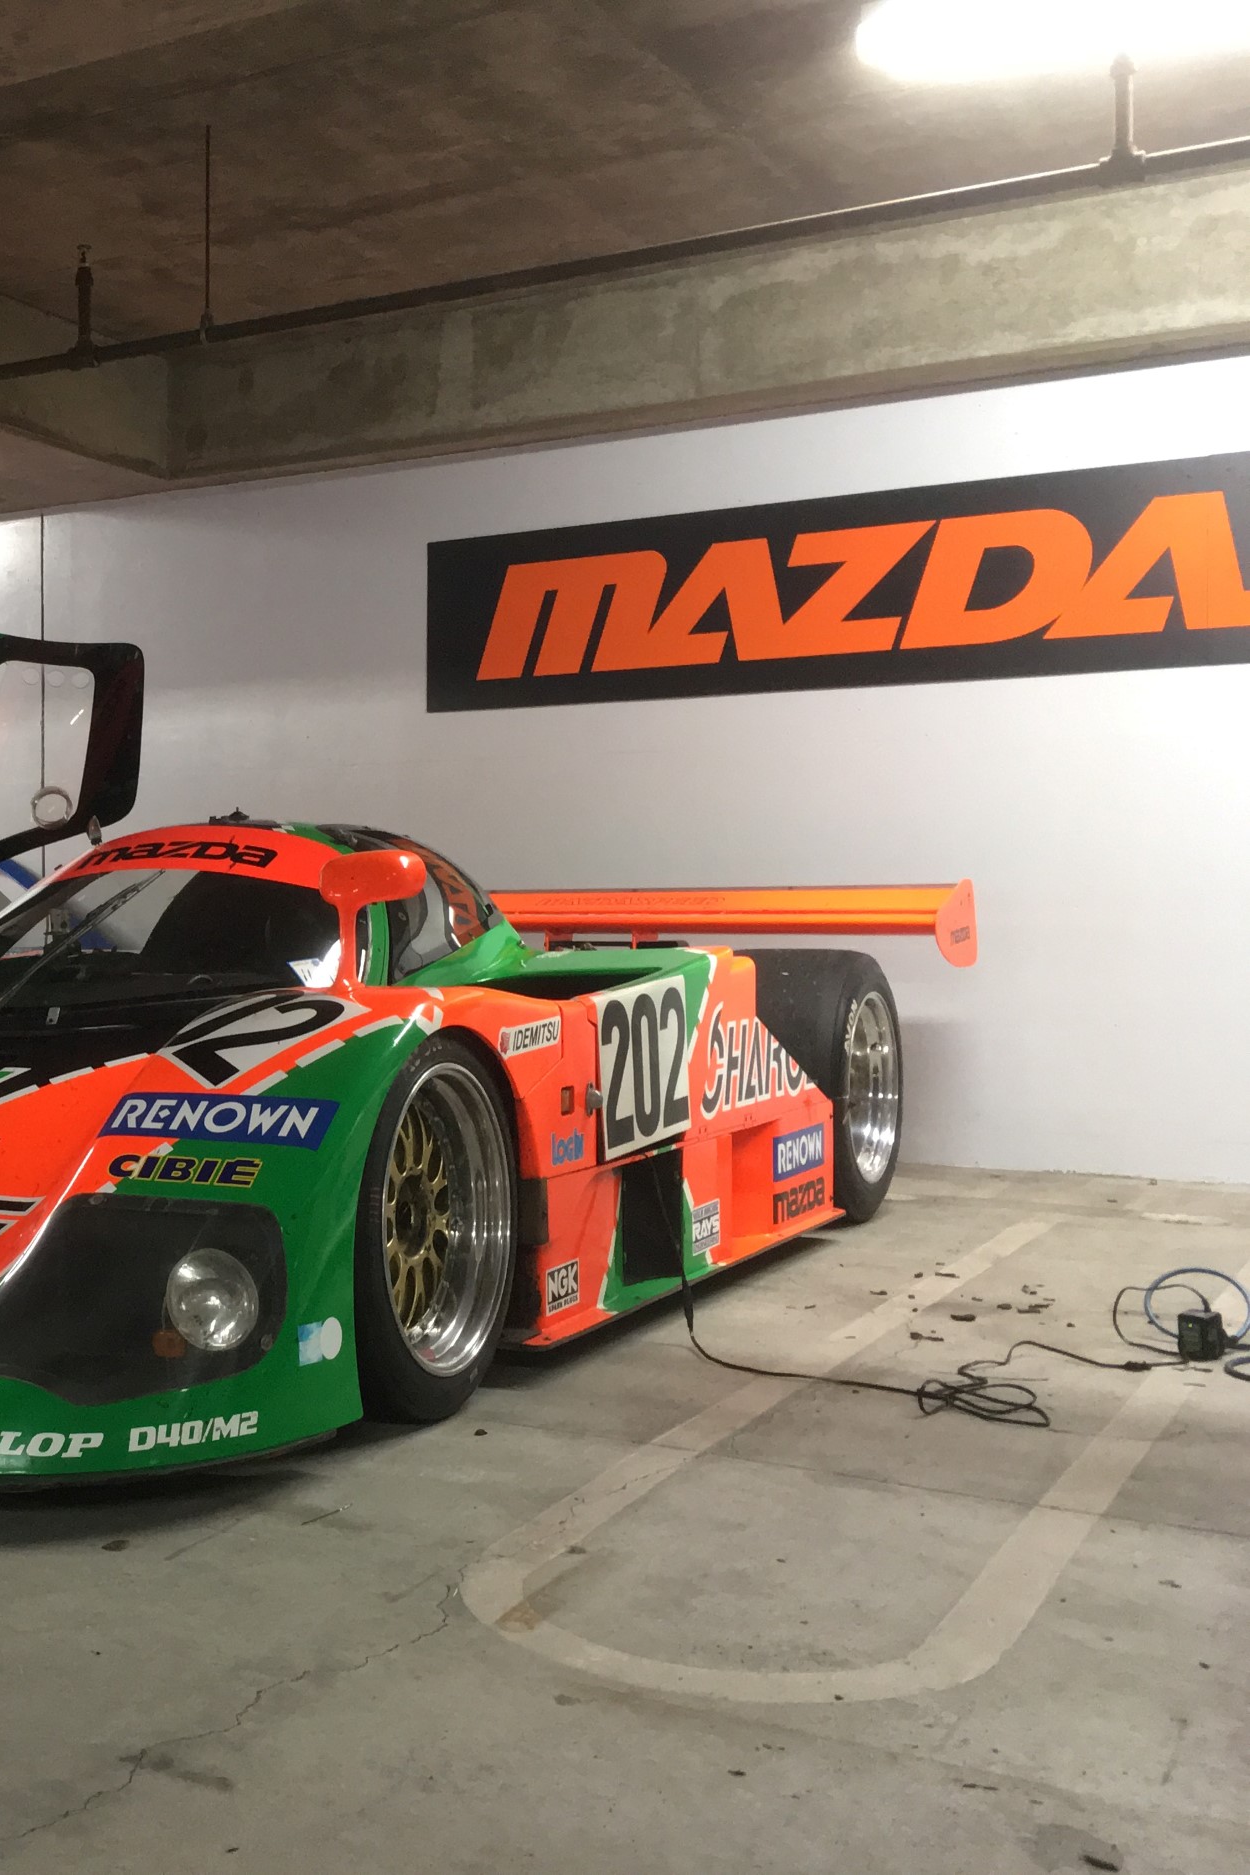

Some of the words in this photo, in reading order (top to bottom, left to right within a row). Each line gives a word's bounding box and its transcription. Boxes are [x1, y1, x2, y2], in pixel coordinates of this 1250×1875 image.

[512, 1018, 560, 1052] IDEMITSU
[601, 987, 690, 1150] 202
[111, 1098, 320, 1140] RENOWN
[777, 1130, 823, 1175] RENOWN
[693, 1213, 720, 1244] RAYS
[548, 1263, 578, 1304] NGK
[128, 1410, 259, 1453] D40/M2
